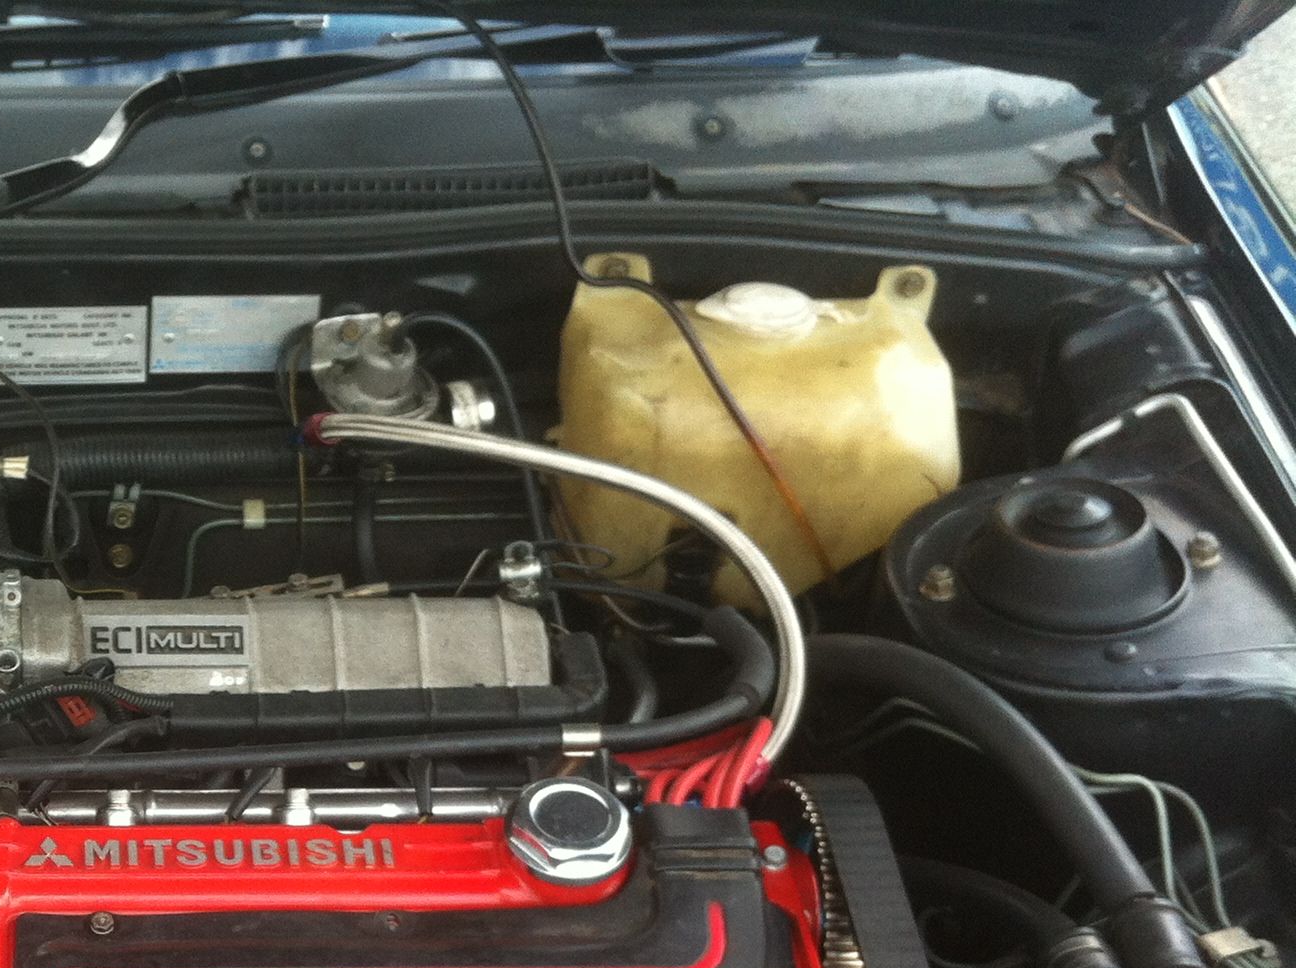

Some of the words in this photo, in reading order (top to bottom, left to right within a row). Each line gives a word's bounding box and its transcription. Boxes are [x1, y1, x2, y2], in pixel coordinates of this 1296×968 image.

[90, 626, 142, 654] ECI
[149, 632, 241, 649] MULTI
[84, 838, 395, 870] MITSUBISHI
